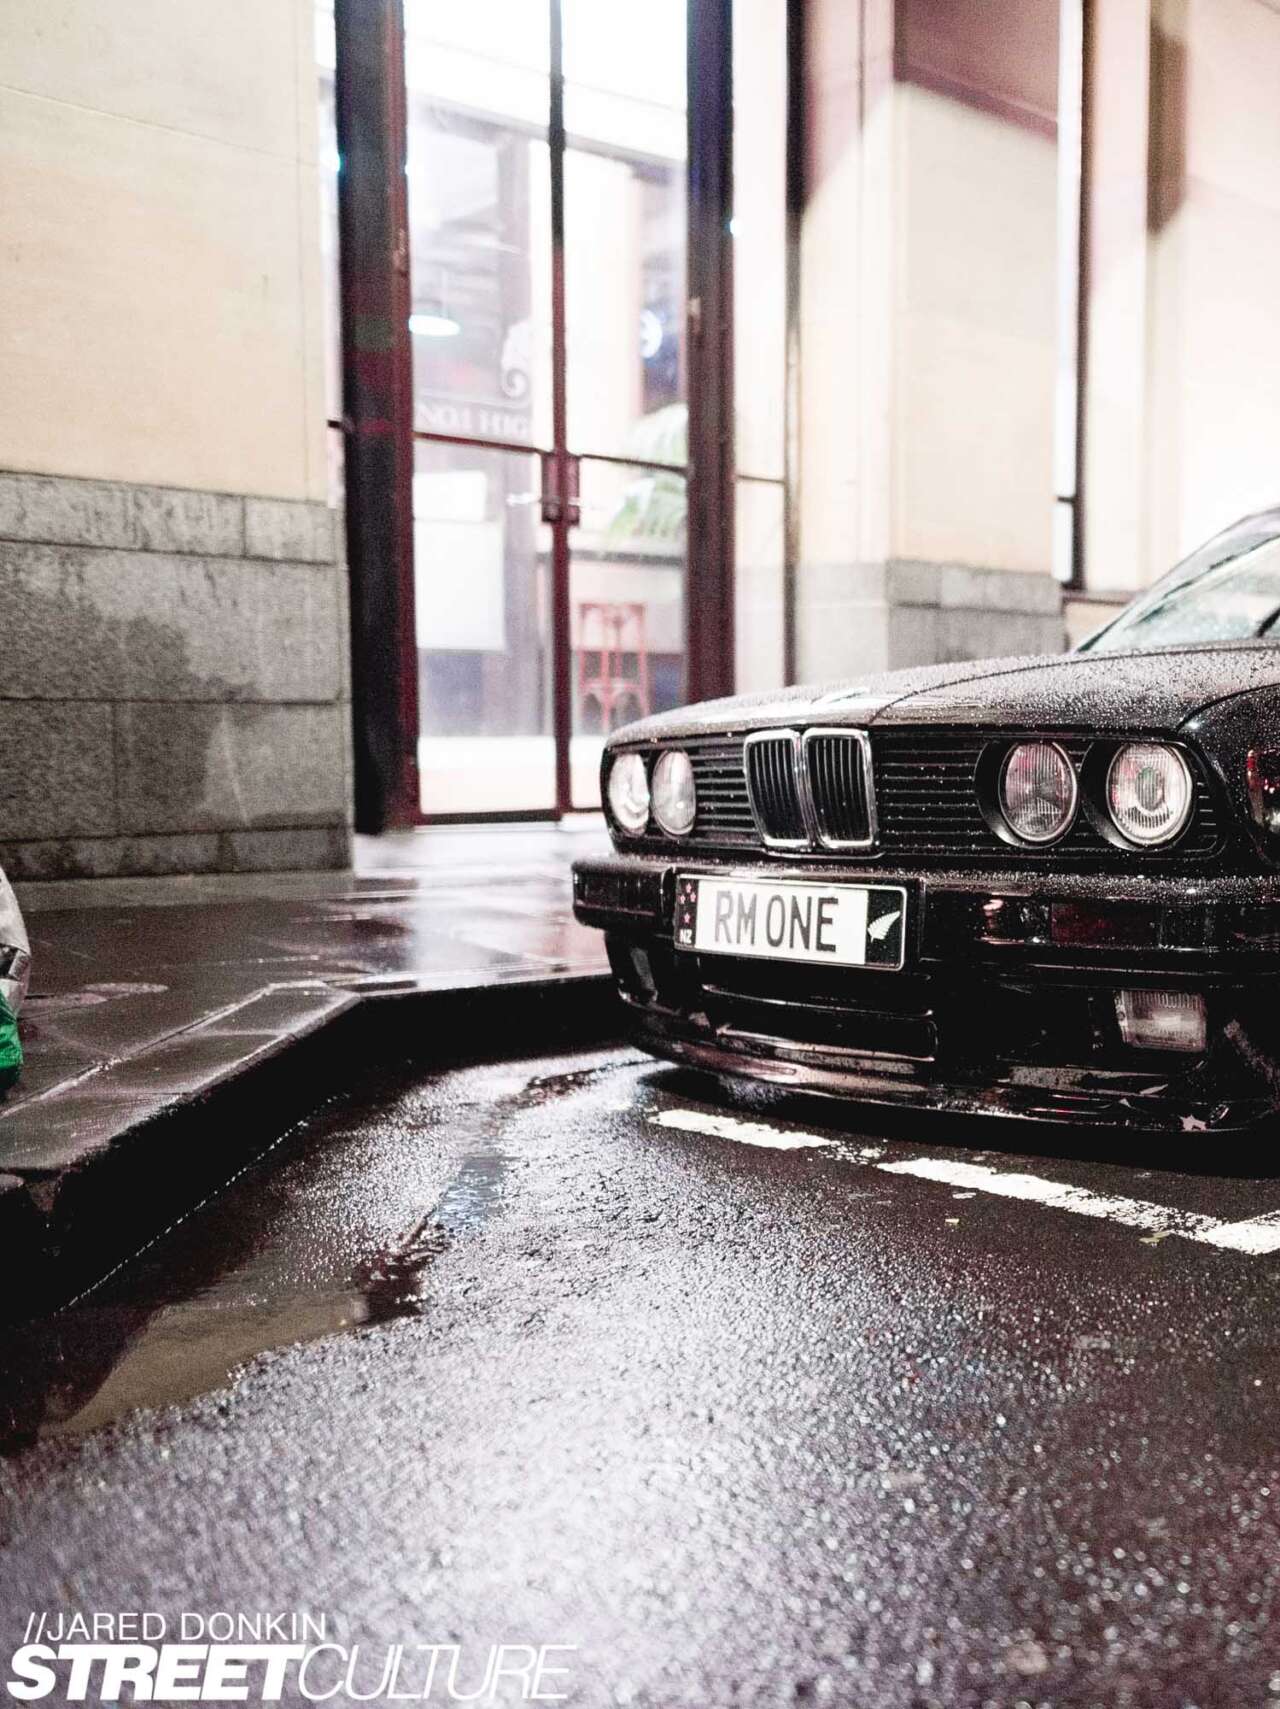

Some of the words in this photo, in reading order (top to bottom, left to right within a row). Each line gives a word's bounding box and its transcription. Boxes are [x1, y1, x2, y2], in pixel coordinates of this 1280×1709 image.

[679, 930, 693, 945] NZ
[714, 890, 757, 945] RM
[765, 894, 839, 953] ONE
